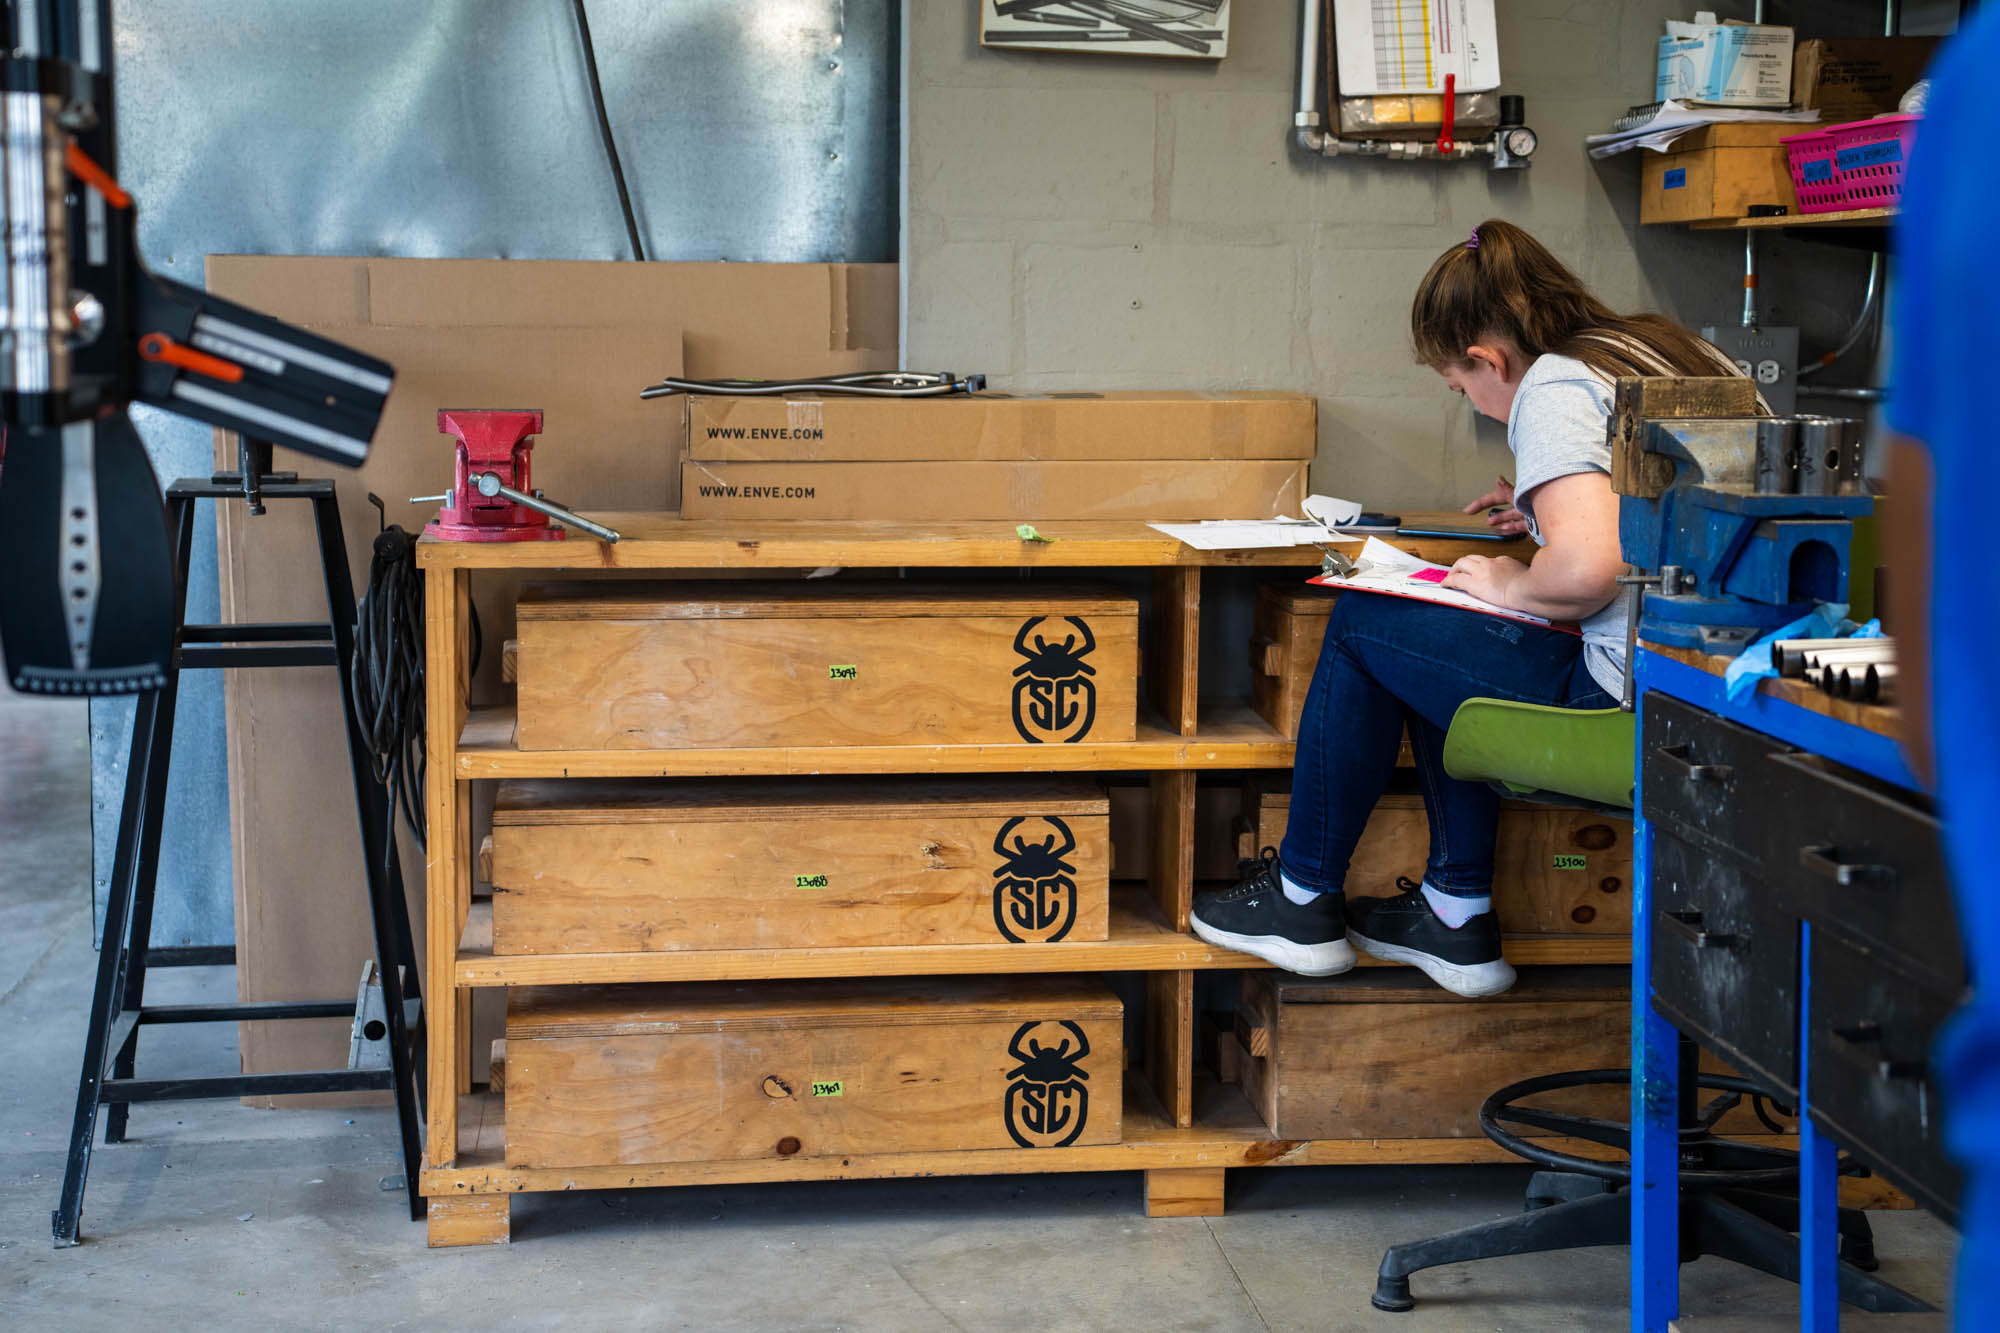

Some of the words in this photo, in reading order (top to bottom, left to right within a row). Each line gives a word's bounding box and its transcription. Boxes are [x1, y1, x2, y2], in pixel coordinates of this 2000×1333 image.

[707, 427, 823, 440] WWW.ENVE.COM
[699, 486, 815, 499] WWW.ENVE.COM
[1029, 680, 1079, 731] SC
[1010, 879, 1060, 930] SC
[1021, 1083, 1072, 1134] SC
